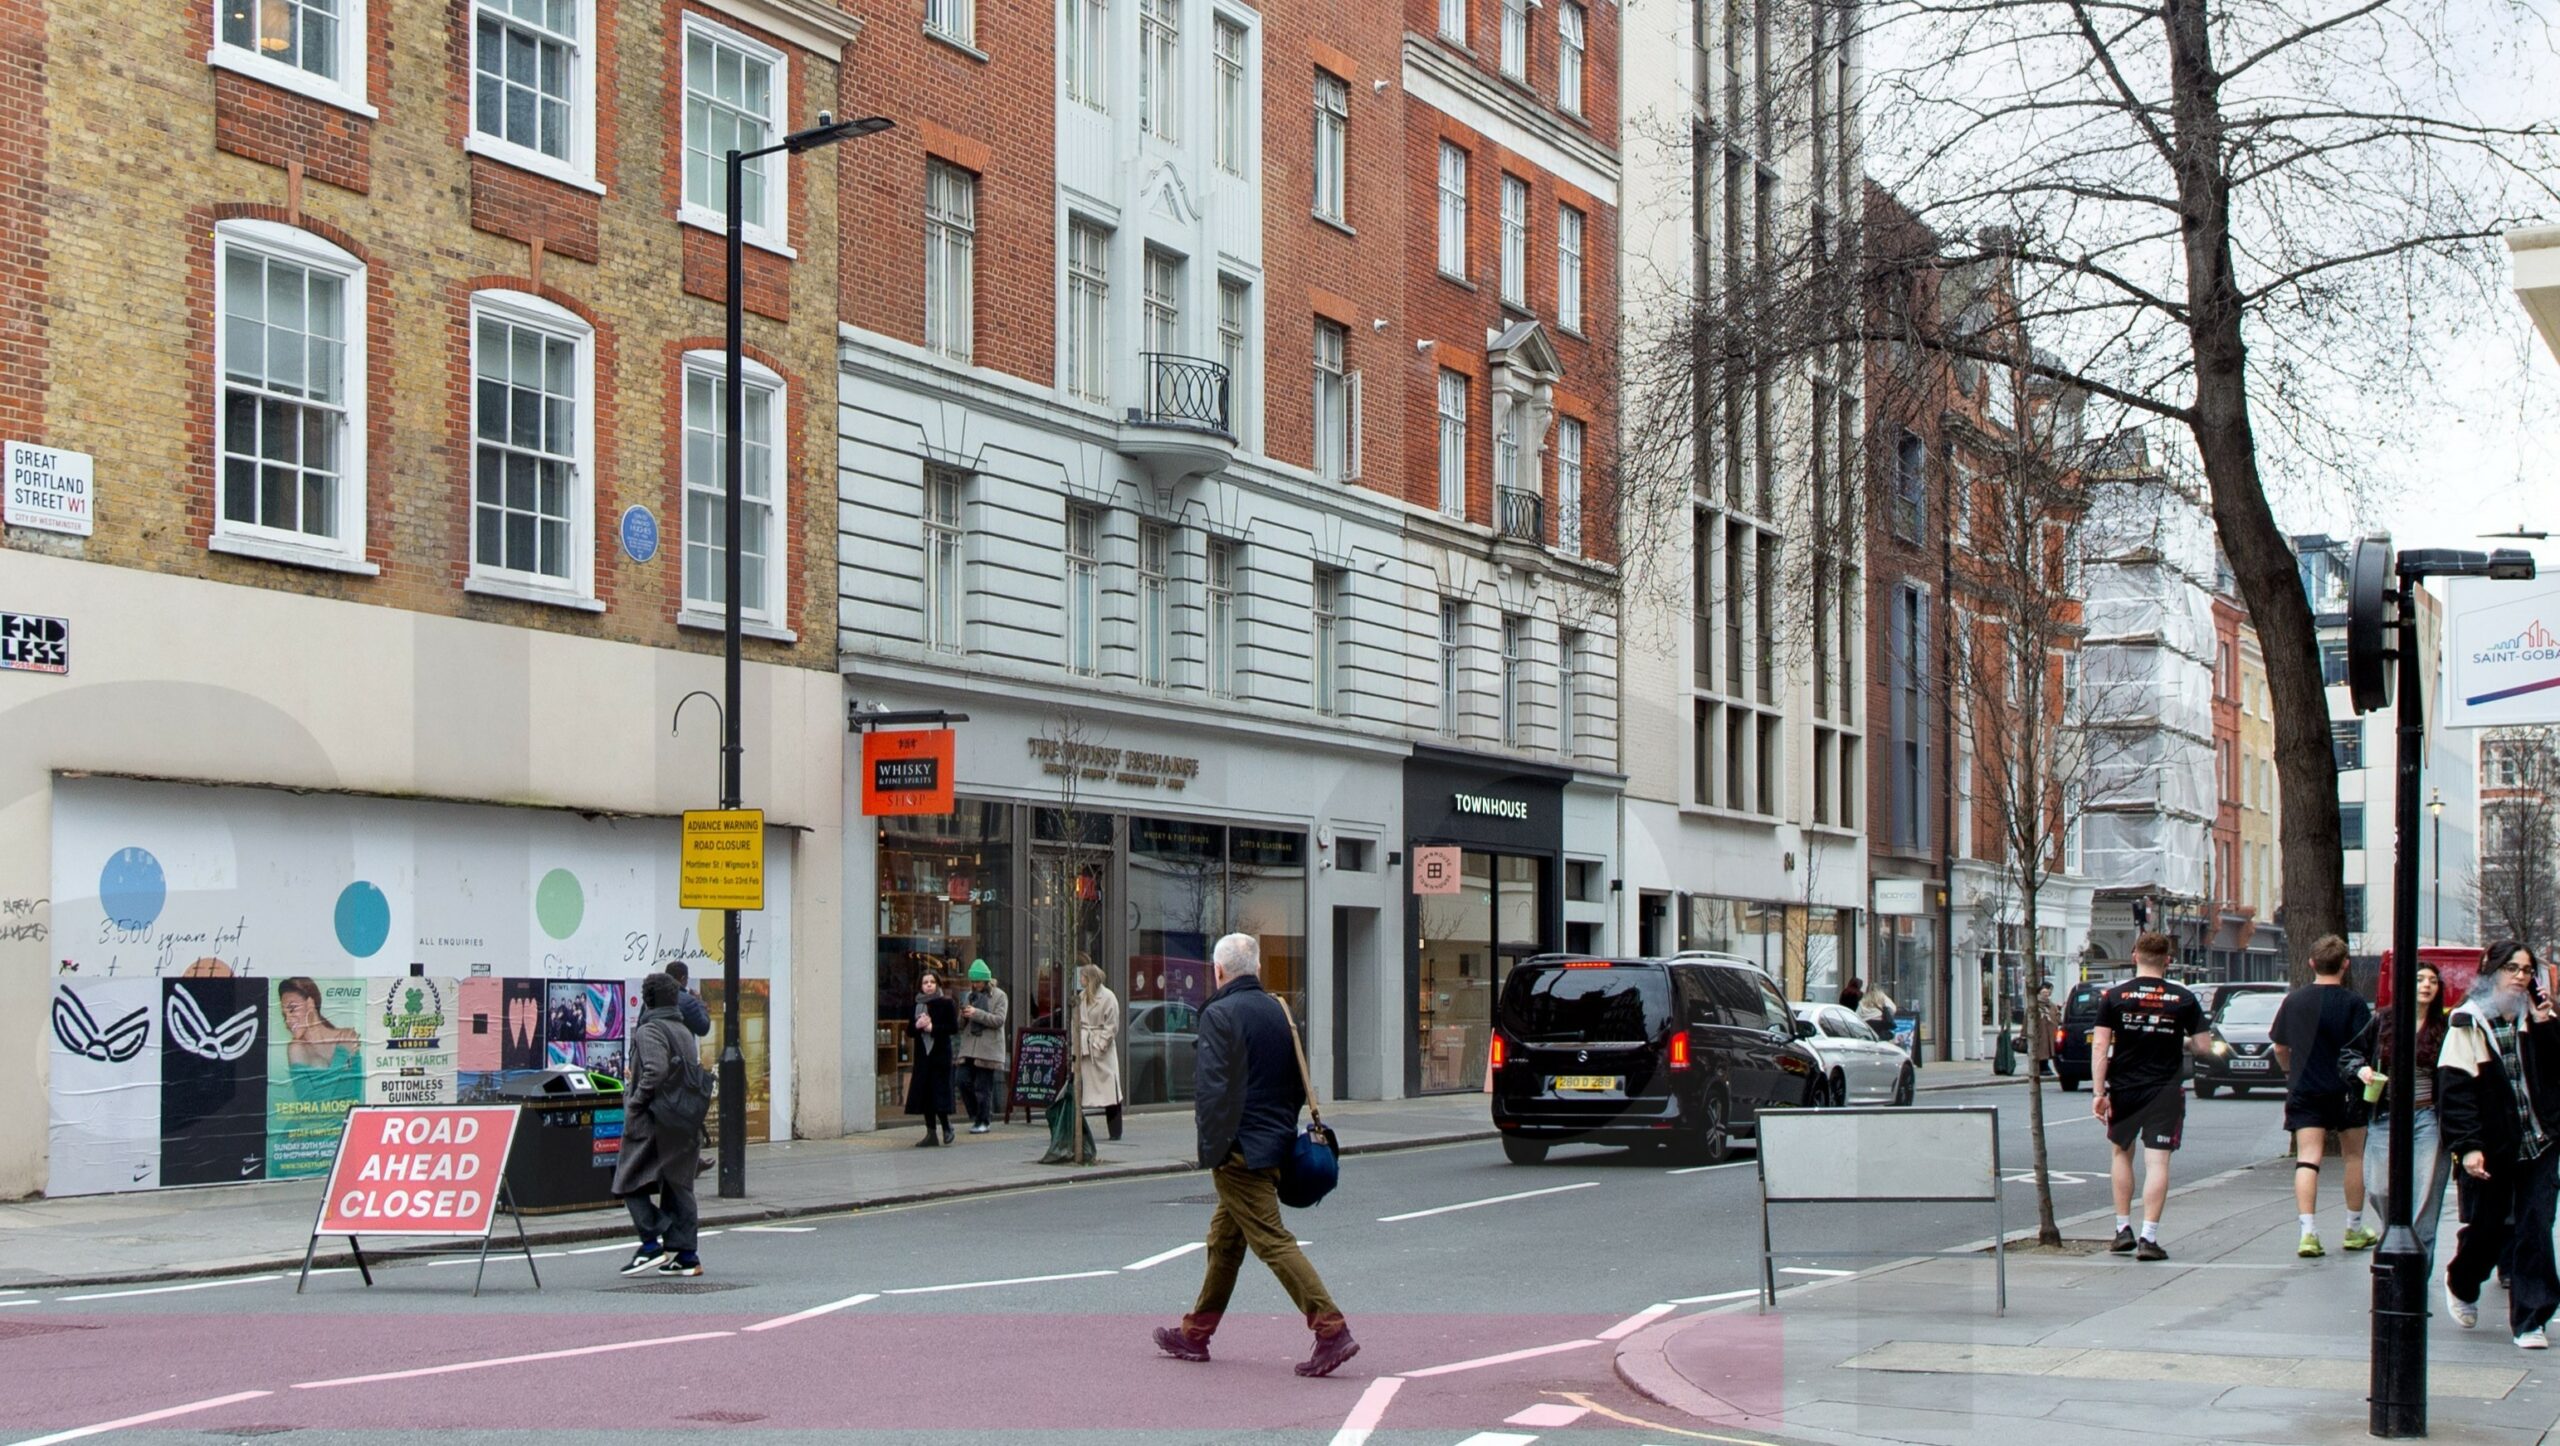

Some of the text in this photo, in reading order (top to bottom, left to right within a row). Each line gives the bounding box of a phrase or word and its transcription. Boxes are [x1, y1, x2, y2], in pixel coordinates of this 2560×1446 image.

[15, 448, 57, 470] GREAT
[15, 468, 84, 495] PORTLAND
[15, 488, 85, 514] STREET W1
[15, 513, 82, 531] CITY OF WESTMINSTER
[879, 763, 931, 776] WHISKY
[1125, 750, 1200, 778] EXCHANGE
[904, 777, 932, 785] SPIRITS
[1455, 793, 1528, 819] TOWNHOUSE
[688, 820, 759, 831] ADVANCE WARNING
[694, 840, 751, 851] ROAD CLOSURE
[686, 860, 711, 869] Mortimer
[713, 861, 720, 869] St
[725, 860, 750, 871] Wigmore
[752, 860, 759, 869] St
[709, 876, 719, 885] Feb
[723, 876, 734, 885] Sun
[749, 876, 760, 885] Feb
[158, 931, 207, 960] square
[214, 915, 249, 954] foot
[419, 937, 484, 947] ALL ENQUIRIES
[624, 931, 649, 962] 38
[651, 927, 713, 966] Langham
[390, 1026, 437, 1038] DAY FEST
[398, 1040, 429, 1048] LONDON
[376, 1056, 395, 1067] SAT
[415, 1054, 449, 1066] MARCH
[382, 1079, 443, 1092] BOTTOMLESS
[388, 1090, 436, 1103] GUINNESS
[274, 1101, 320, 1115] TEEDRA
[381, 1117, 480, 1145] ROAD
[273, 1142, 301, 1152] SUNDAY
[358, 1154, 480, 1181] AHEAD
[340, 1190, 481, 1218] CLOSED
